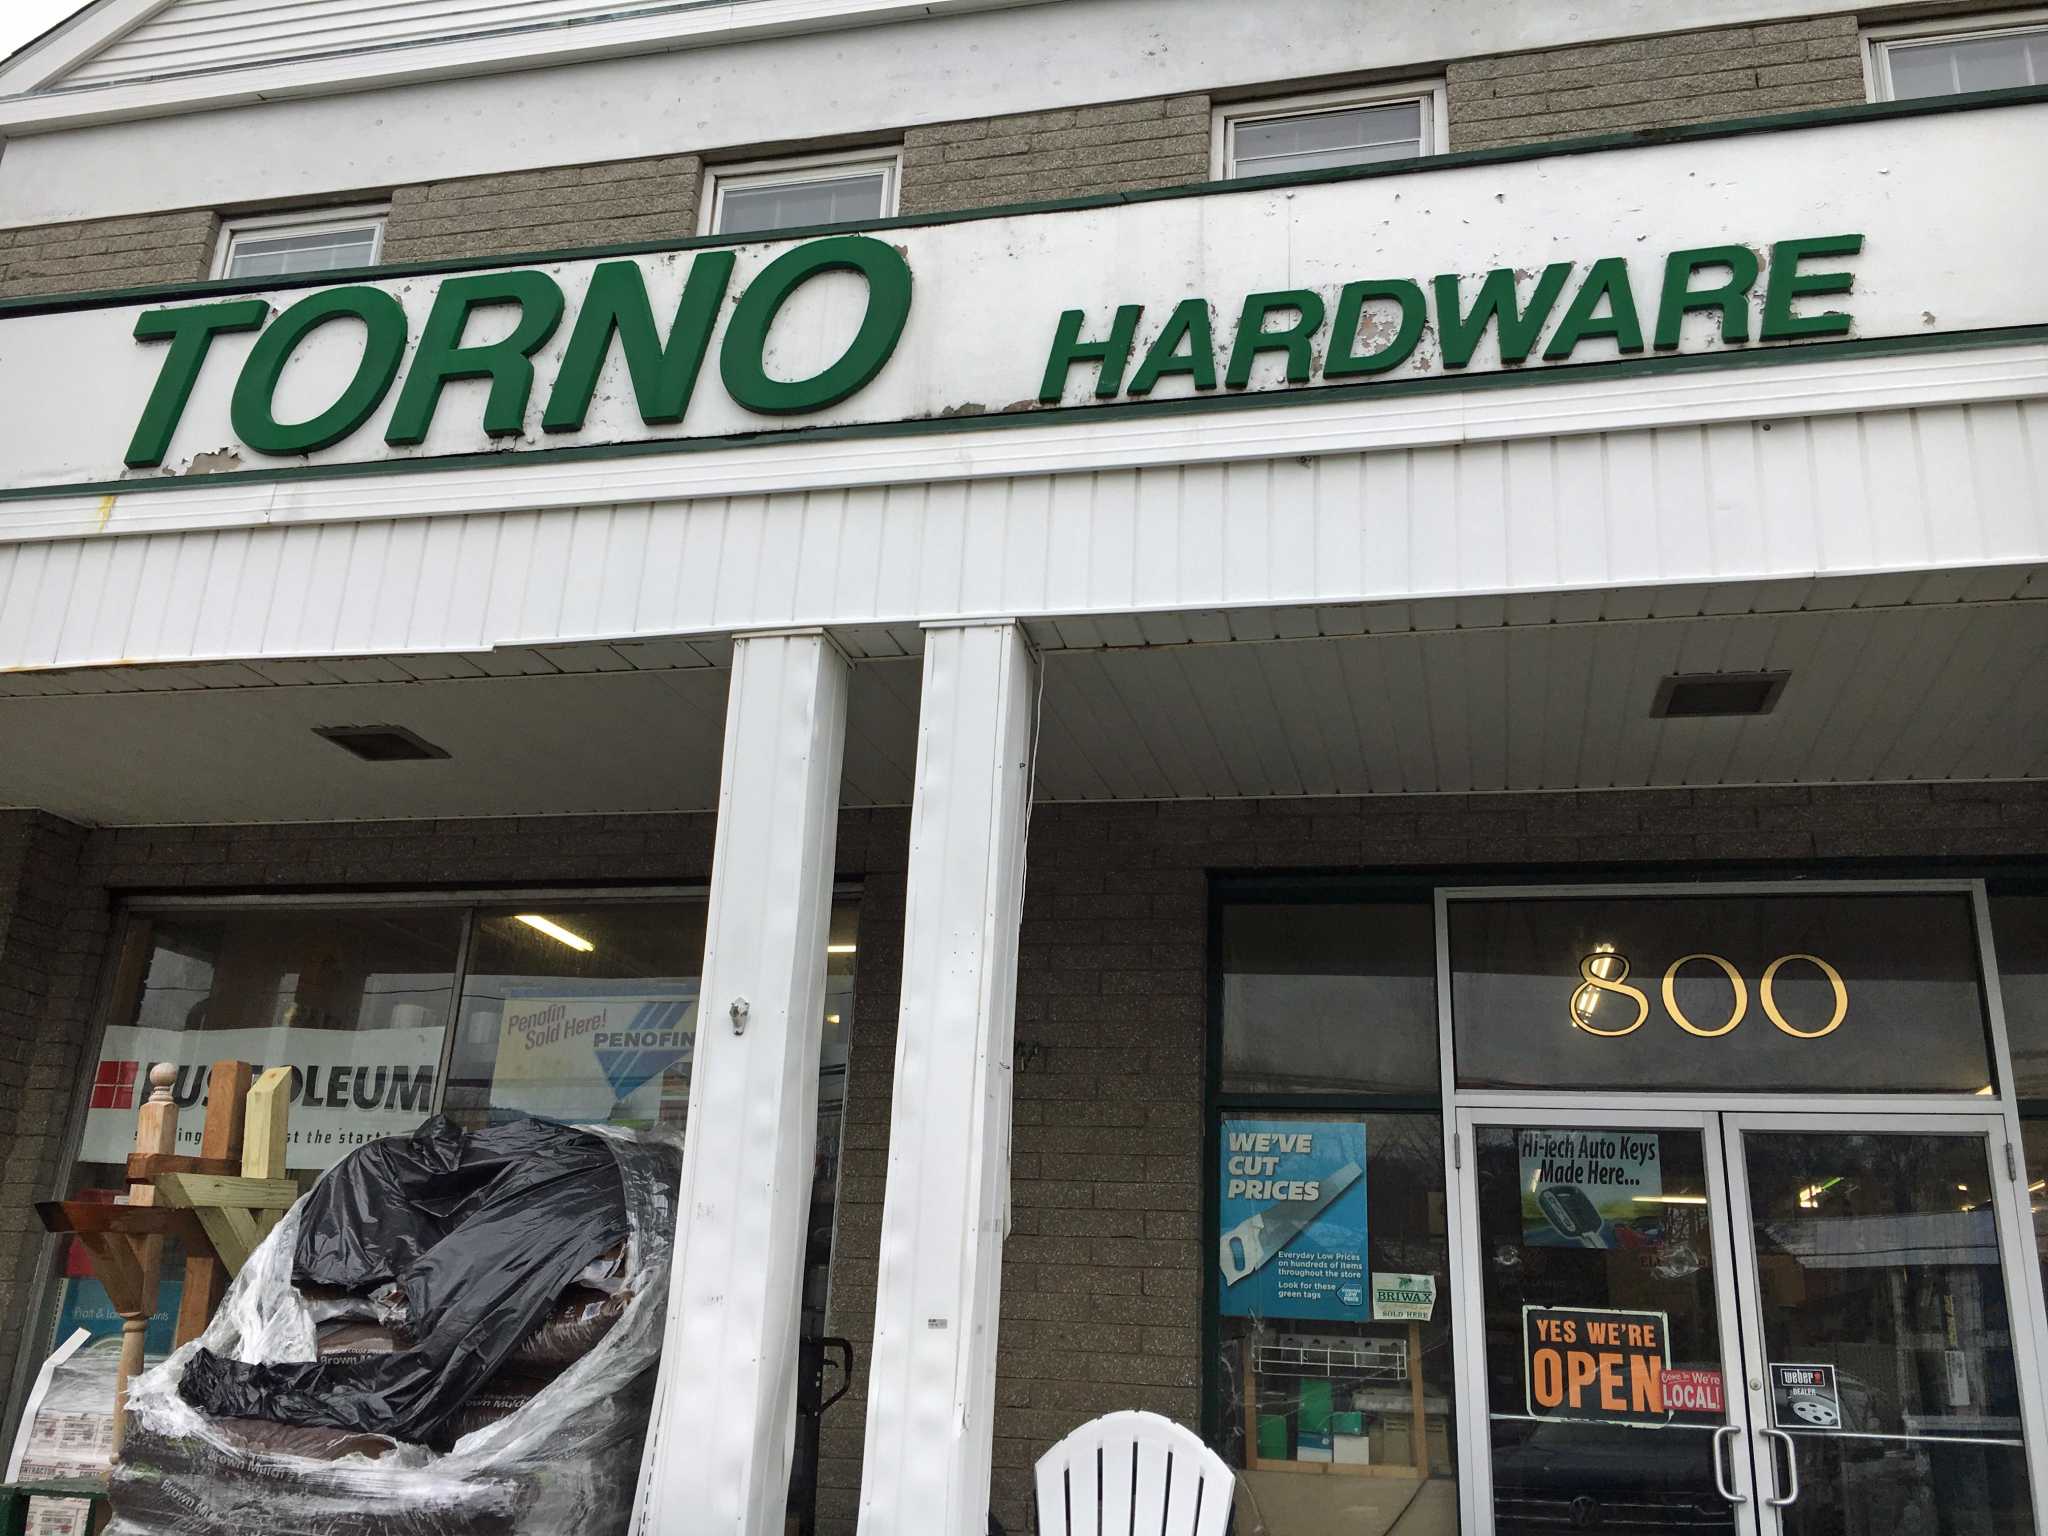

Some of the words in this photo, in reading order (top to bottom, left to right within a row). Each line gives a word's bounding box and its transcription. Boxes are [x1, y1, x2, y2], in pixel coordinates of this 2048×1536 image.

[124, 234, 913, 469] TORNO
[1039, 234, 1864, 403] HARDWARE
[1569, 951, 1848, 1038] 800
[508, 1003, 567, 1035] Penofin
[525, 1021, 560, 1050] Sold
[563, 1008, 608, 1040] Here!
[593, 1031, 695, 1048] PENOFIN
[306, 1129, 332, 1144] the
[1228, 1132, 1313, 1154] WE'VE
[1522, 1131, 1574, 1158] Hi-Tech
[1578, 1135, 1616, 1160] Auto
[1619, 1136, 1656, 1166] Keys
[1227, 1155, 1280, 1177] CUT
[1539, 1159, 1584, 1184] Made
[1587, 1160, 1640, 1186] Here...
[1227, 1179, 1321, 1201] PRICES
[1278, 1251, 1315, 1260] Everyday
[1317, 1252, 1333, 1260] Low
[1335, 1252, 1361, 1261] Prices
[1290, 1260, 1328, 1269] hundreds
[1278, 1268, 1324, 1278] throughout
[1325, 1270, 1339, 1278] the
[1340, 1271, 1362, 1279] store
[1278, 1281, 1299, 1289] Look
[1300, 1281, 1312, 1289] for
[1314, 1283, 1337, 1291] these
[1278, 1291, 1302, 1299] green
[1303, 1291, 1321, 1300] tags
[1376, 1291, 1432, 1304] BRIWAX
[1406, 1311, 1428, 1319] HERE
[1536, 1319, 1577, 1343] YES
[1586, 1321, 1657, 1347] WE'RE
[1533, 1348, 1665, 1413] OPEN
[1691, 1371, 1721, 1385] We're
[1783, 1369, 1813, 1384] weber
[1662, 1384, 1721, 1409] LOCAL!
[1793, 1387, 1817, 1396] DEALER
[207, 1449, 245, 1470] Brown
[161, 1479, 195, 1508] Brown
